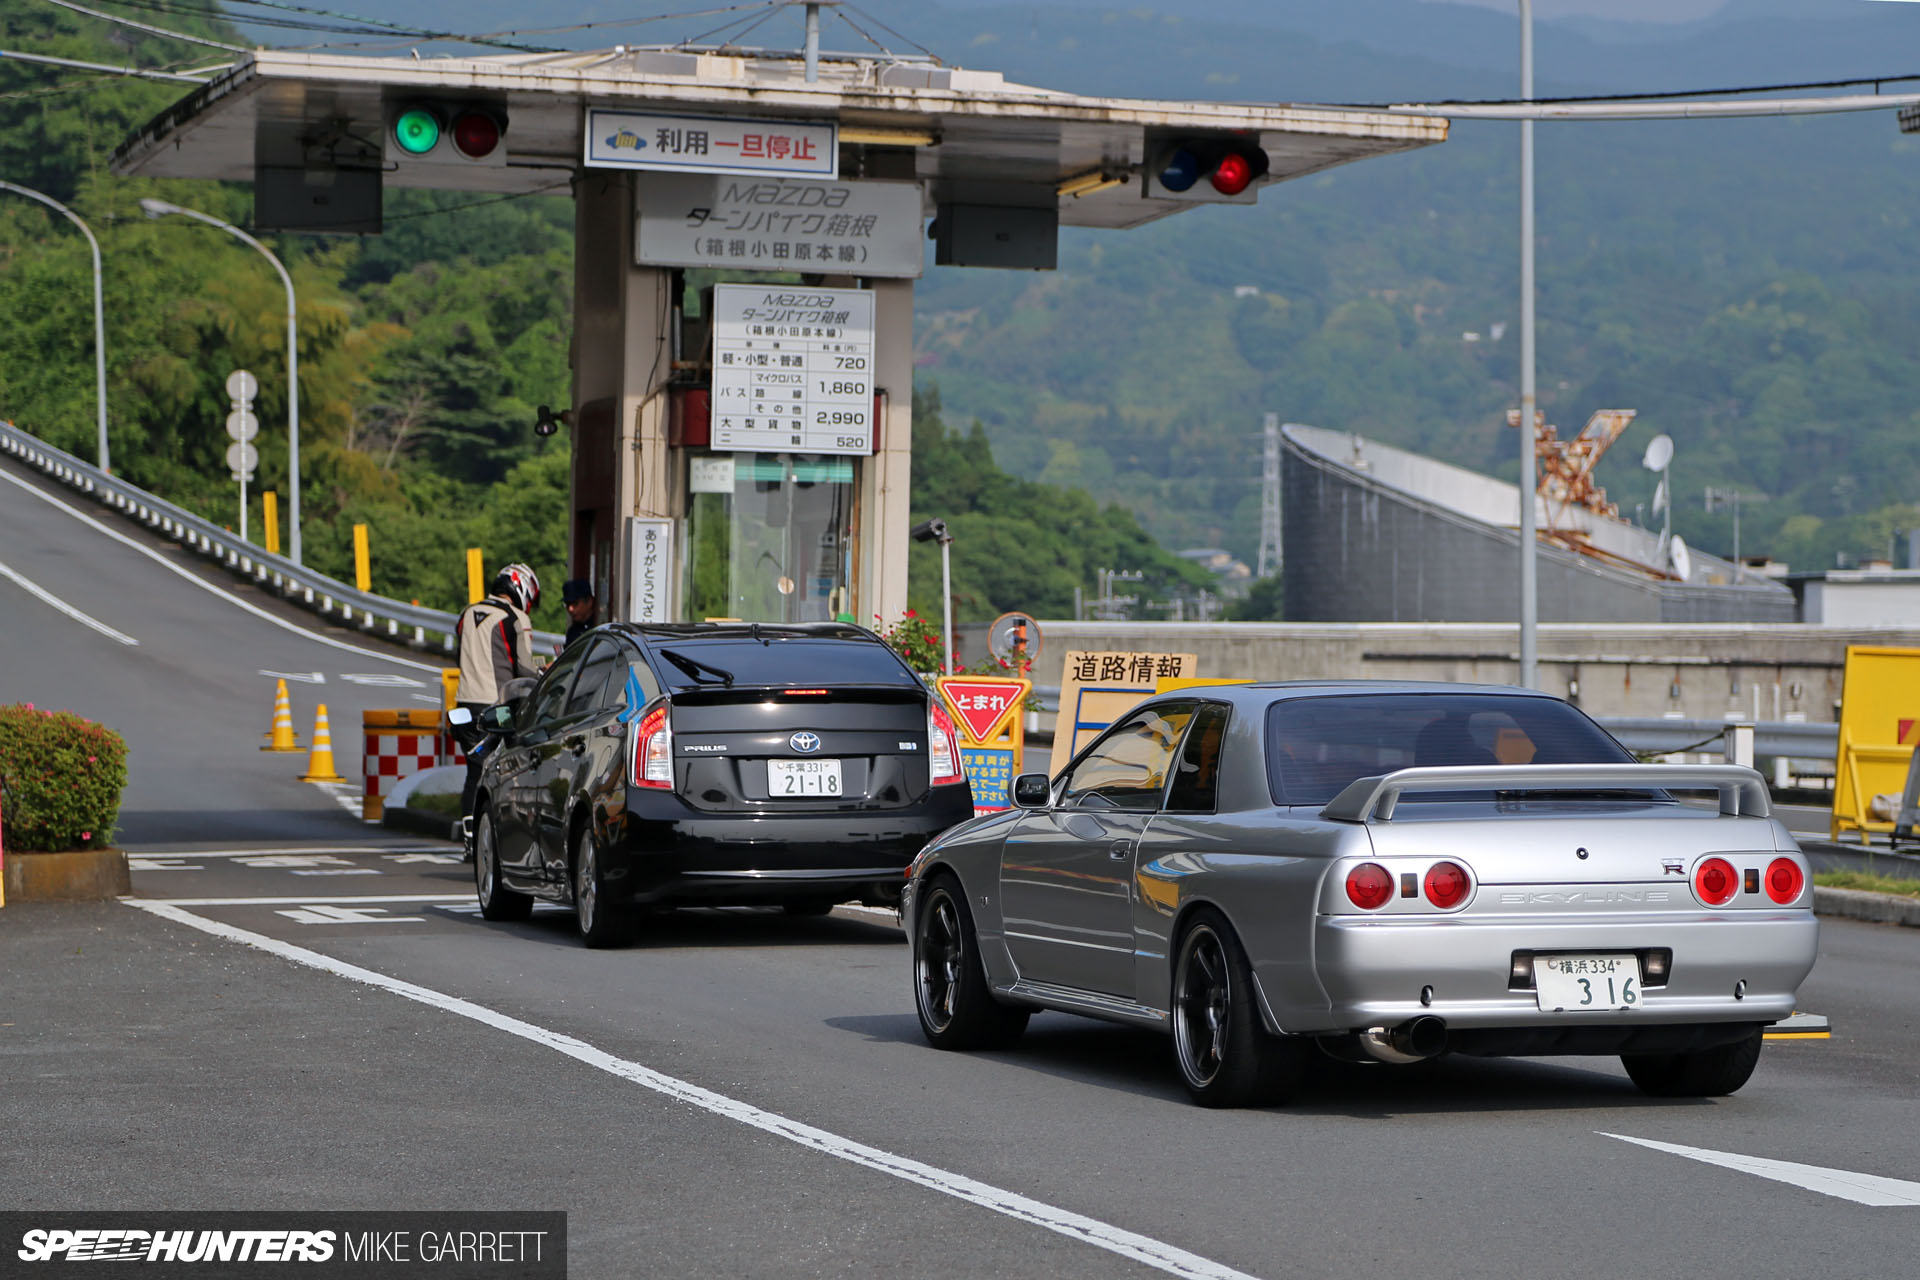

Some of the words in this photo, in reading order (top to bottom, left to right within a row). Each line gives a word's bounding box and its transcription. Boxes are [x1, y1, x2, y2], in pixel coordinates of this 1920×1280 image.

[656, 128, 708, 155] 利用
[714, 134, 816, 160] 一旦停止
[686, 207, 878, 238] ターンパイク箱根
[834, 357, 865, 370] 720
[819, 381, 865, 395] 1,860
[816, 411, 864, 426] 2,990
[836, 437, 864, 448] 520
[643, 529, 657, 622] ありがとうござ
[1072, 655, 1182, 683] 道路情報
[957, 694, 1006, 711] とまれ
[684, 744, 728, 752] PRIUS
[785, 775, 837, 793] 21-18
[1500, 890, 1669, 904] SKYLINE
